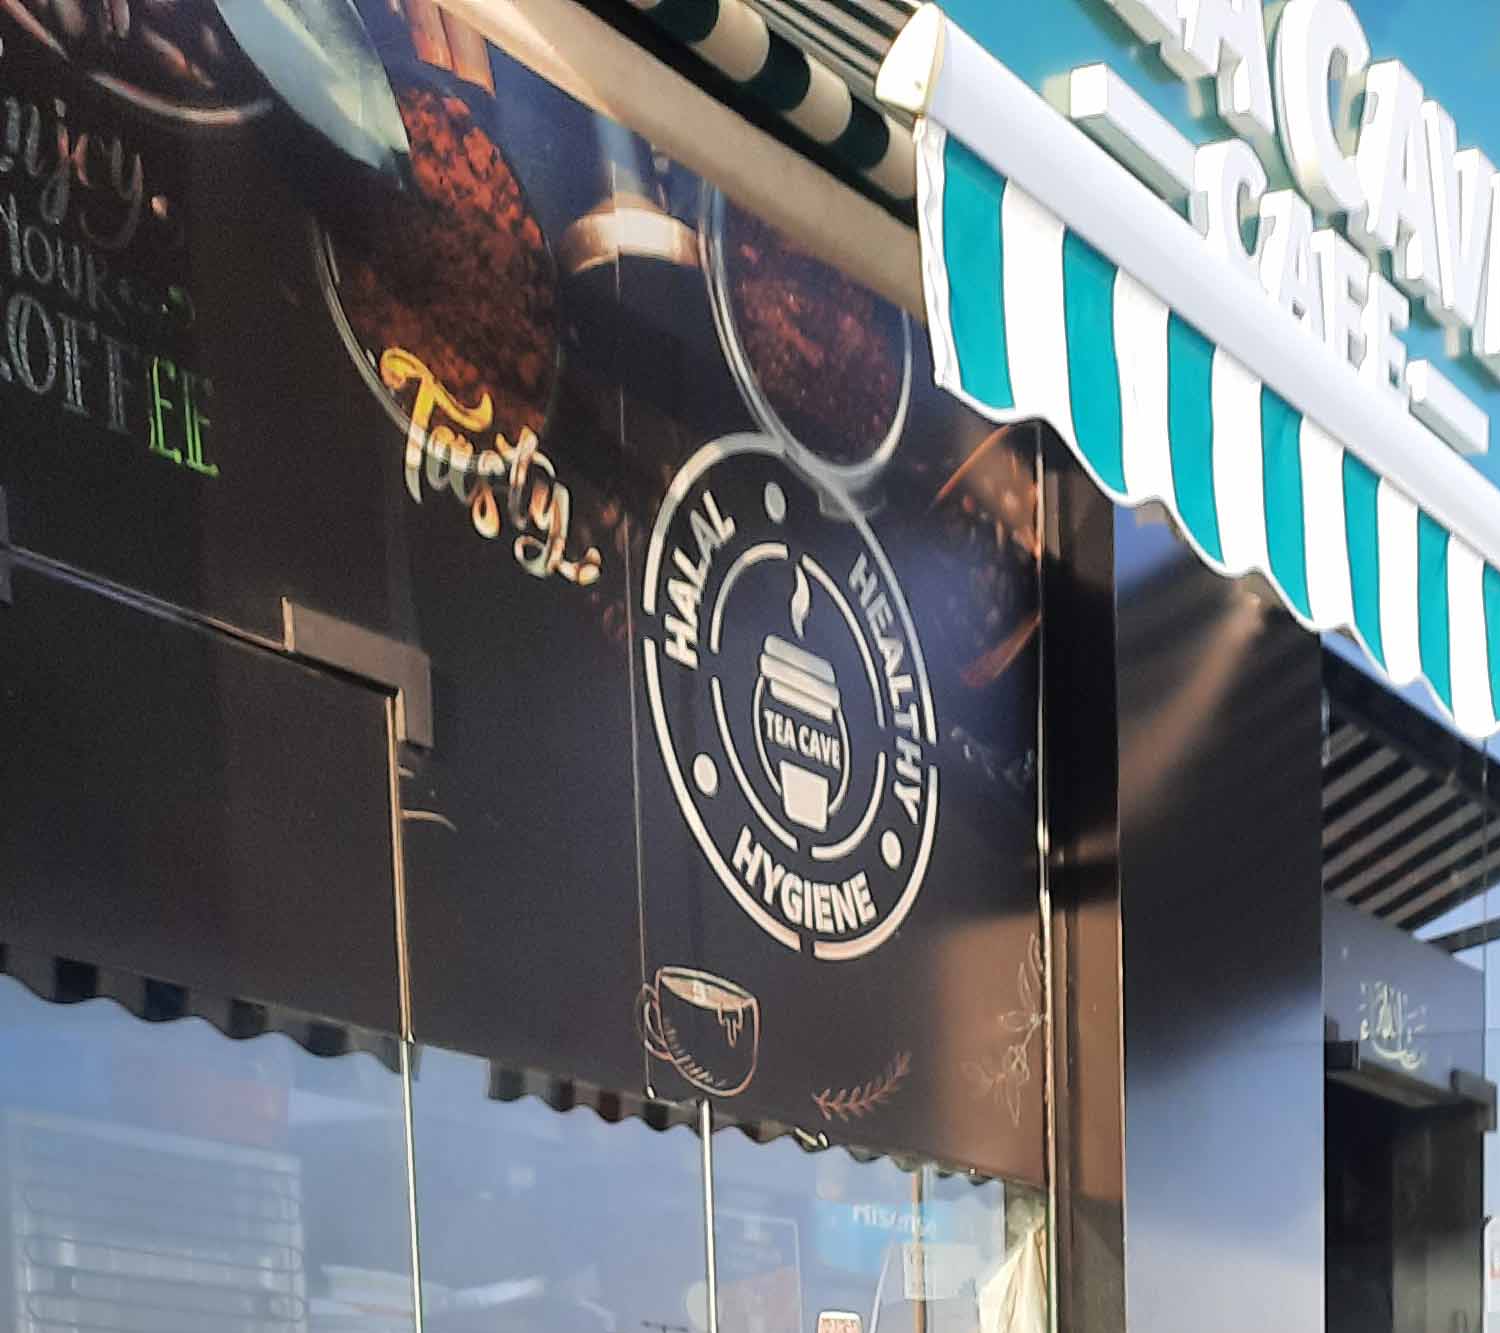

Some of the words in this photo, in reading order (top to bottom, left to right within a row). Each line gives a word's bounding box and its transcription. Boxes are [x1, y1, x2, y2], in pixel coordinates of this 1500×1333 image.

[0, 292, 220, 478] OFFEE
[664, 489, 737, 671] HALAL
[763, 707, 798, 752] TEA
[799, 724, 841, 770] CAVE
[847, 551, 925, 825] HEALTHY
[732, 825, 879, 935] HYGIENE
